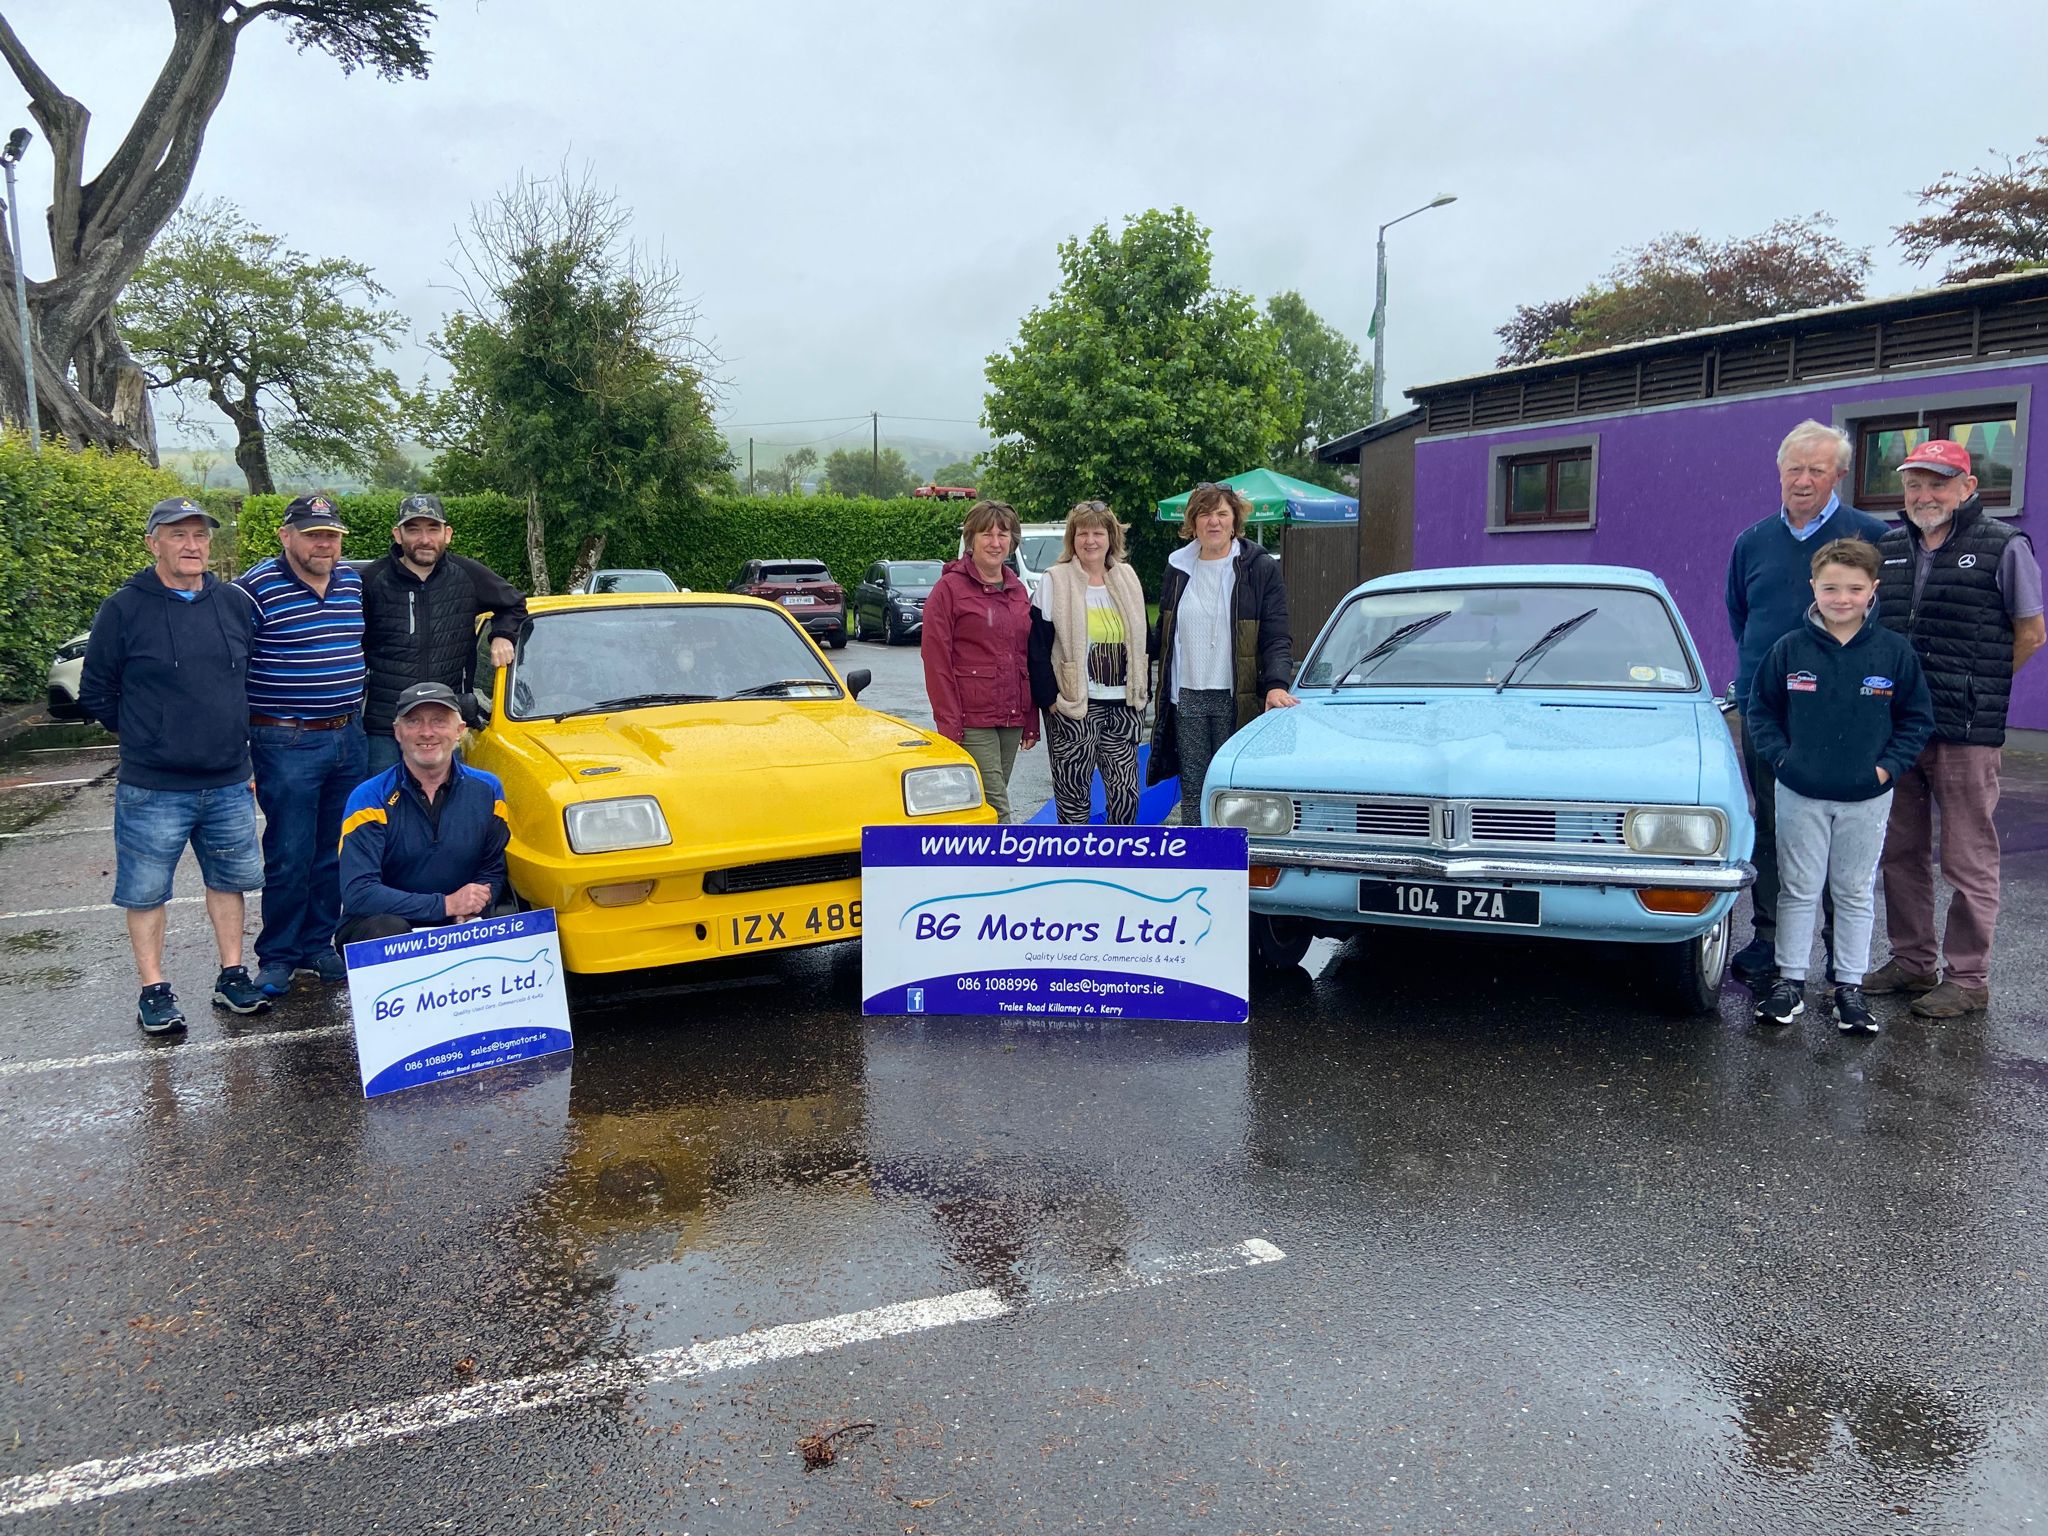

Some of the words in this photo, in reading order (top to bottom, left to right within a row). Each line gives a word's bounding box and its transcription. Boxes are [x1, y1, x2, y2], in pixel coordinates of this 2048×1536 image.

[921, 828, 1187, 863] www.bgmotors.ie
[805, 900, 862, 934] 488
[1396, 886, 1439, 913] 104
[1457, 890, 1505, 919] PZA
[384, 918, 525, 956] www.bgmotors.ie
[915, 913, 961, 941] BG
[977, 913, 1100, 942] Motors
[1115, 915, 1186, 945] Ltd.
[1024, 952, 1055, 962] Quality
[1057, 952, 1077, 962] Used
[1079, 952, 1100, 963] Cars,
[1102, 954, 1153, 963] Commercials
[1155, 954, 1161, 963] &
[1163, 955, 1186, 964] 4x4's
[376, 997, 405, 1021] BG
[416, 984, 492, 1013] Motors
[501, 970, 542, 994] Ltd.
[957, 977, 981, 991] 086
[985, 978, 1038, 992] 1088996
[1049, 979, 1165, 996] sales@bgmotors.ie
[999, 1002, 1023, 1011] Tralee
[1026, 1003, 1045, 1012] Road
[1048, 1003, 1082, 1015] Killarney
[1084, 1004, 1097, 1013] Co.
[1100, 1005, 1123, 1016] Kerry
[404, 1059, 423, 1072] 086
[425, 1050, 464, 1067] 1088996
[470, 1031, 547, 1057] sales@bgmotors.ie
[436, 1068, 455, 1078] Tralee
[456, 1064, 470, 1073] Road
[471, 1059, 495, 1070] Killarney
[507, 1053, 523, 1061] Kerry
